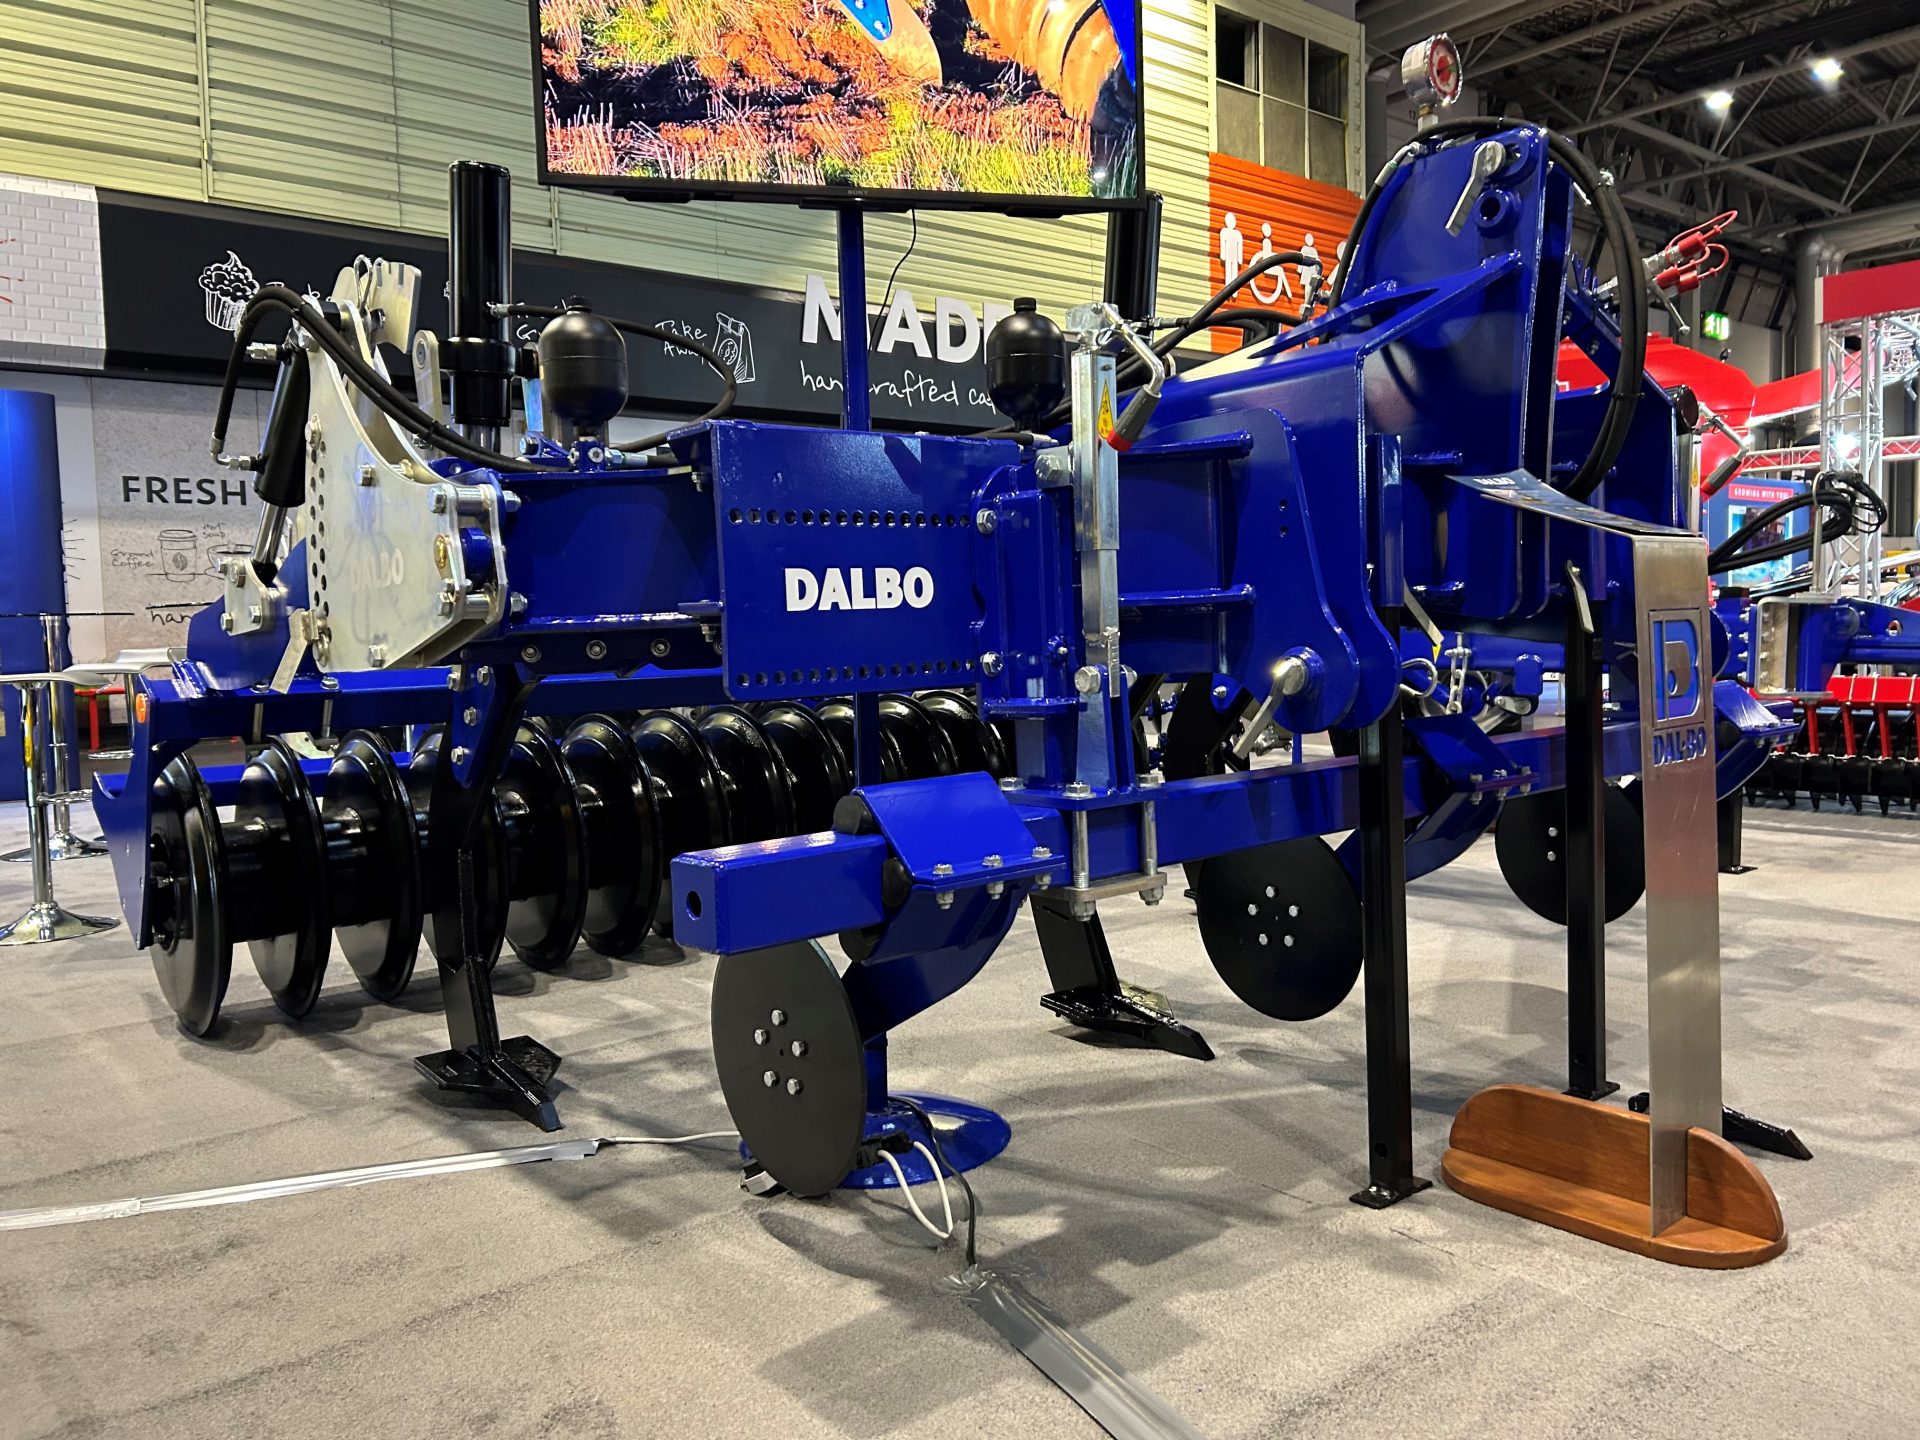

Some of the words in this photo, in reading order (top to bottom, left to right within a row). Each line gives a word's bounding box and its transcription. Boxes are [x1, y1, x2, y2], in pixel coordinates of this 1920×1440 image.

[655, 320, 707, 340] Take
[800, 360, 959, 407] hanrafted
[122, 475, 247, 506] FRESH
[1761, 490, 1775, 499] WITH
[784, 566, 935, 612] DALBO
